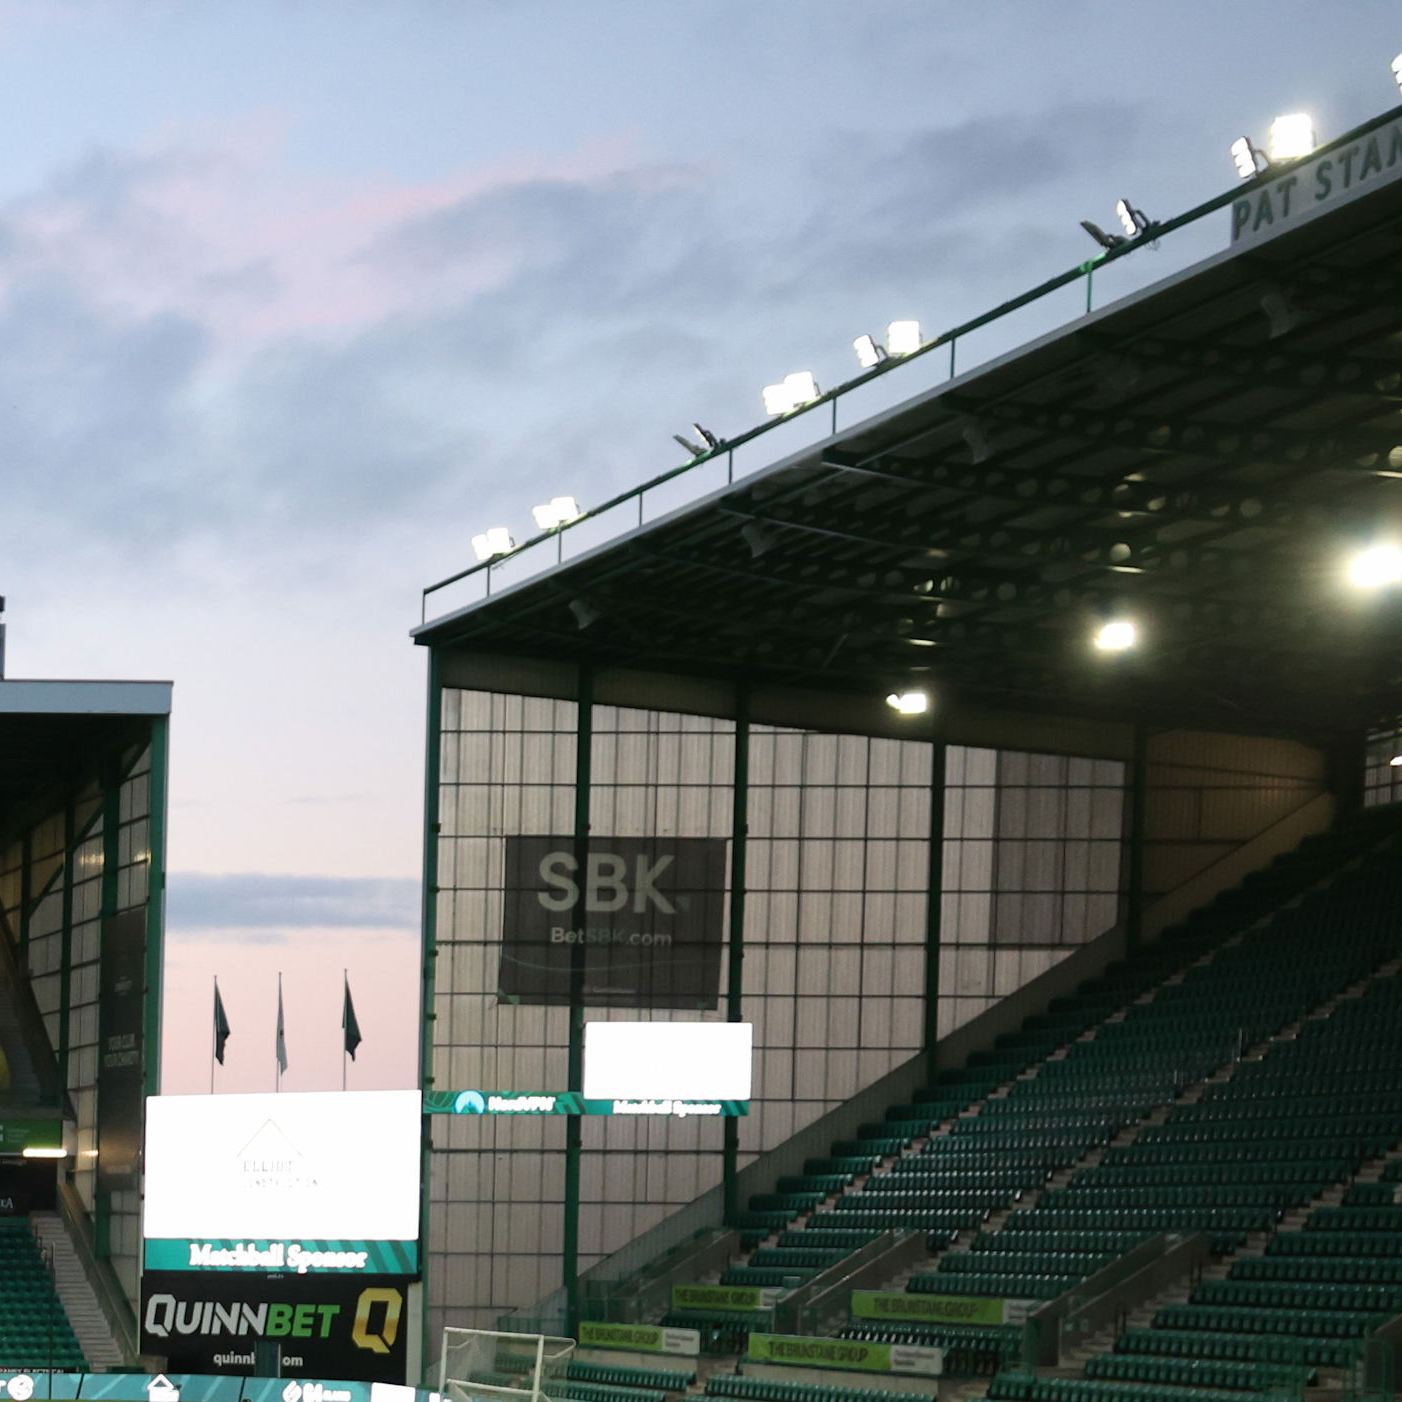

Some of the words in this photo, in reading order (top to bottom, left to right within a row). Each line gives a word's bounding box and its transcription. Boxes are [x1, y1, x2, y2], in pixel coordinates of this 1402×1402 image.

[1232, 176, 1298, 241] PAT
[537, 851, 677, 914] SBK
[550, 926, 673, 947] BetSBK.com
[189, 1244, 285, 1267] Matchball
[286, 1244, 368, 1274] Sponsor
[145, 1294, 340, 1337] QUINNBET
[352, 1288, 403, 1353] Q
